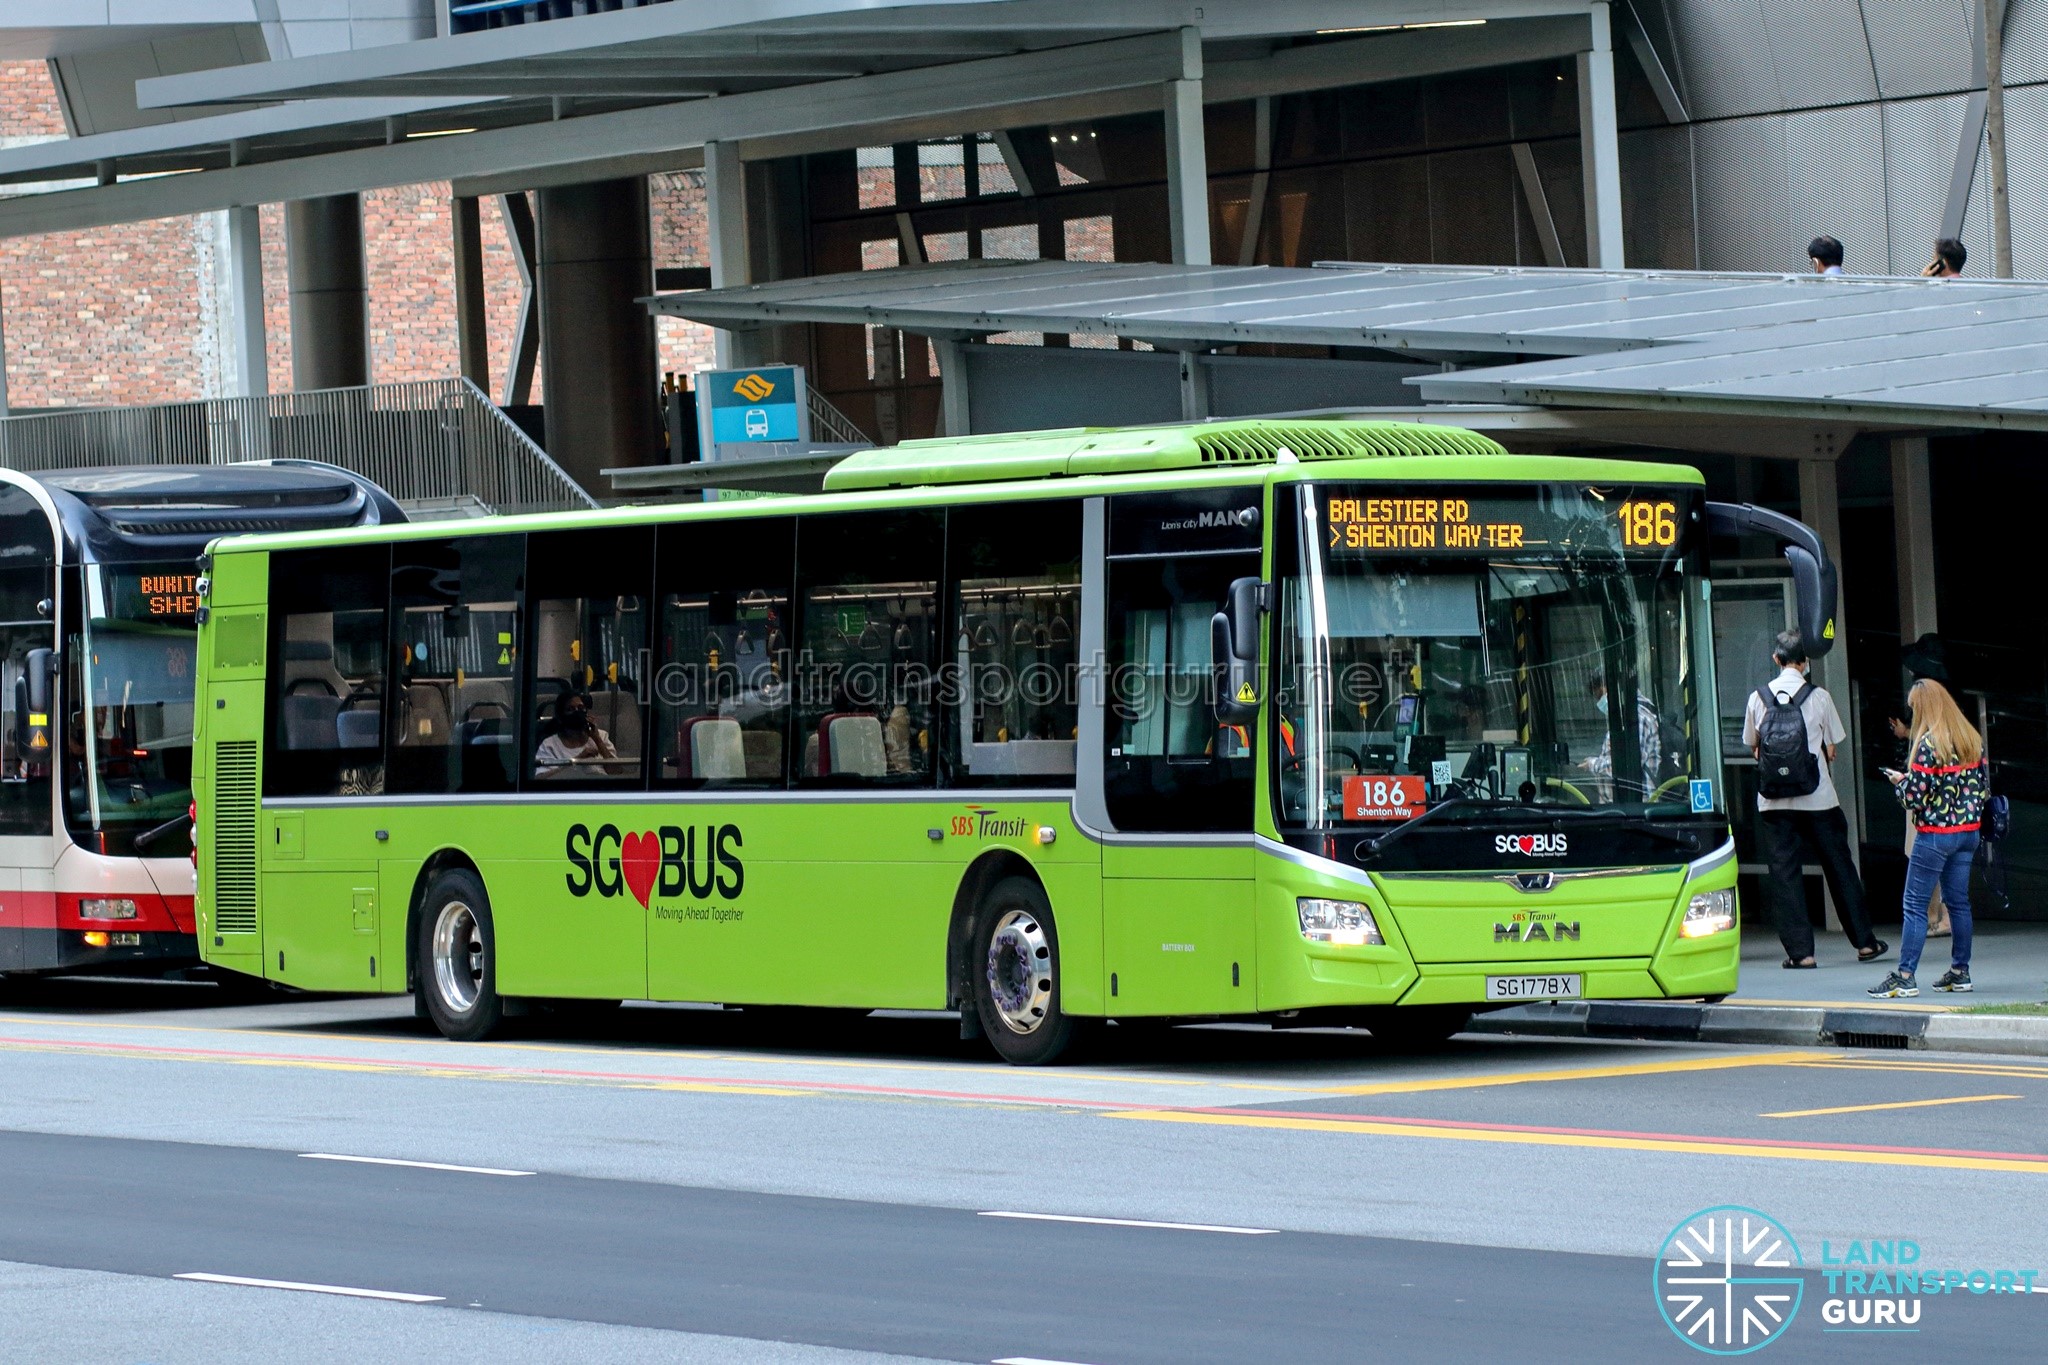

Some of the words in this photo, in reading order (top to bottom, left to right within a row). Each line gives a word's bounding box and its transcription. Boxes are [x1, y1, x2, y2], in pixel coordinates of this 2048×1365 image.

[1182, 519, 1198, 529] City
[1199, 509, 1241, 528] MAN
[1329, 500, 1438, 523] BALESTIER
[1443, 500, 1469, 523] RD
[1618, 502, 1676, 546] 186
[1346, 524, 1435, 548] SHENTON
[1444, 524, 1483, 548] WAY
[1487, 524, 1523, 547] TER
[141, 575, 196, 594] BUKIT
[1362, 781, 1406, 806] 186
[1357, 807, 1393, 817] Shenton
[1394, 807, 1412, 818] Way
[951, 816, 974, 836] SBS
[974, 810, 1029, 840] Transit
[655, 906, 684, 923] Moving
[684, 908, 709, 921] Ahead
[711, 908, 744, 924] Together
[1512, 914, 1526, 922] SBS
[1525, 911, 1557, 922] Transit
[1493, 922, 1581, 943] MAN
[1497, 977, 1572, 996] SG1778X
